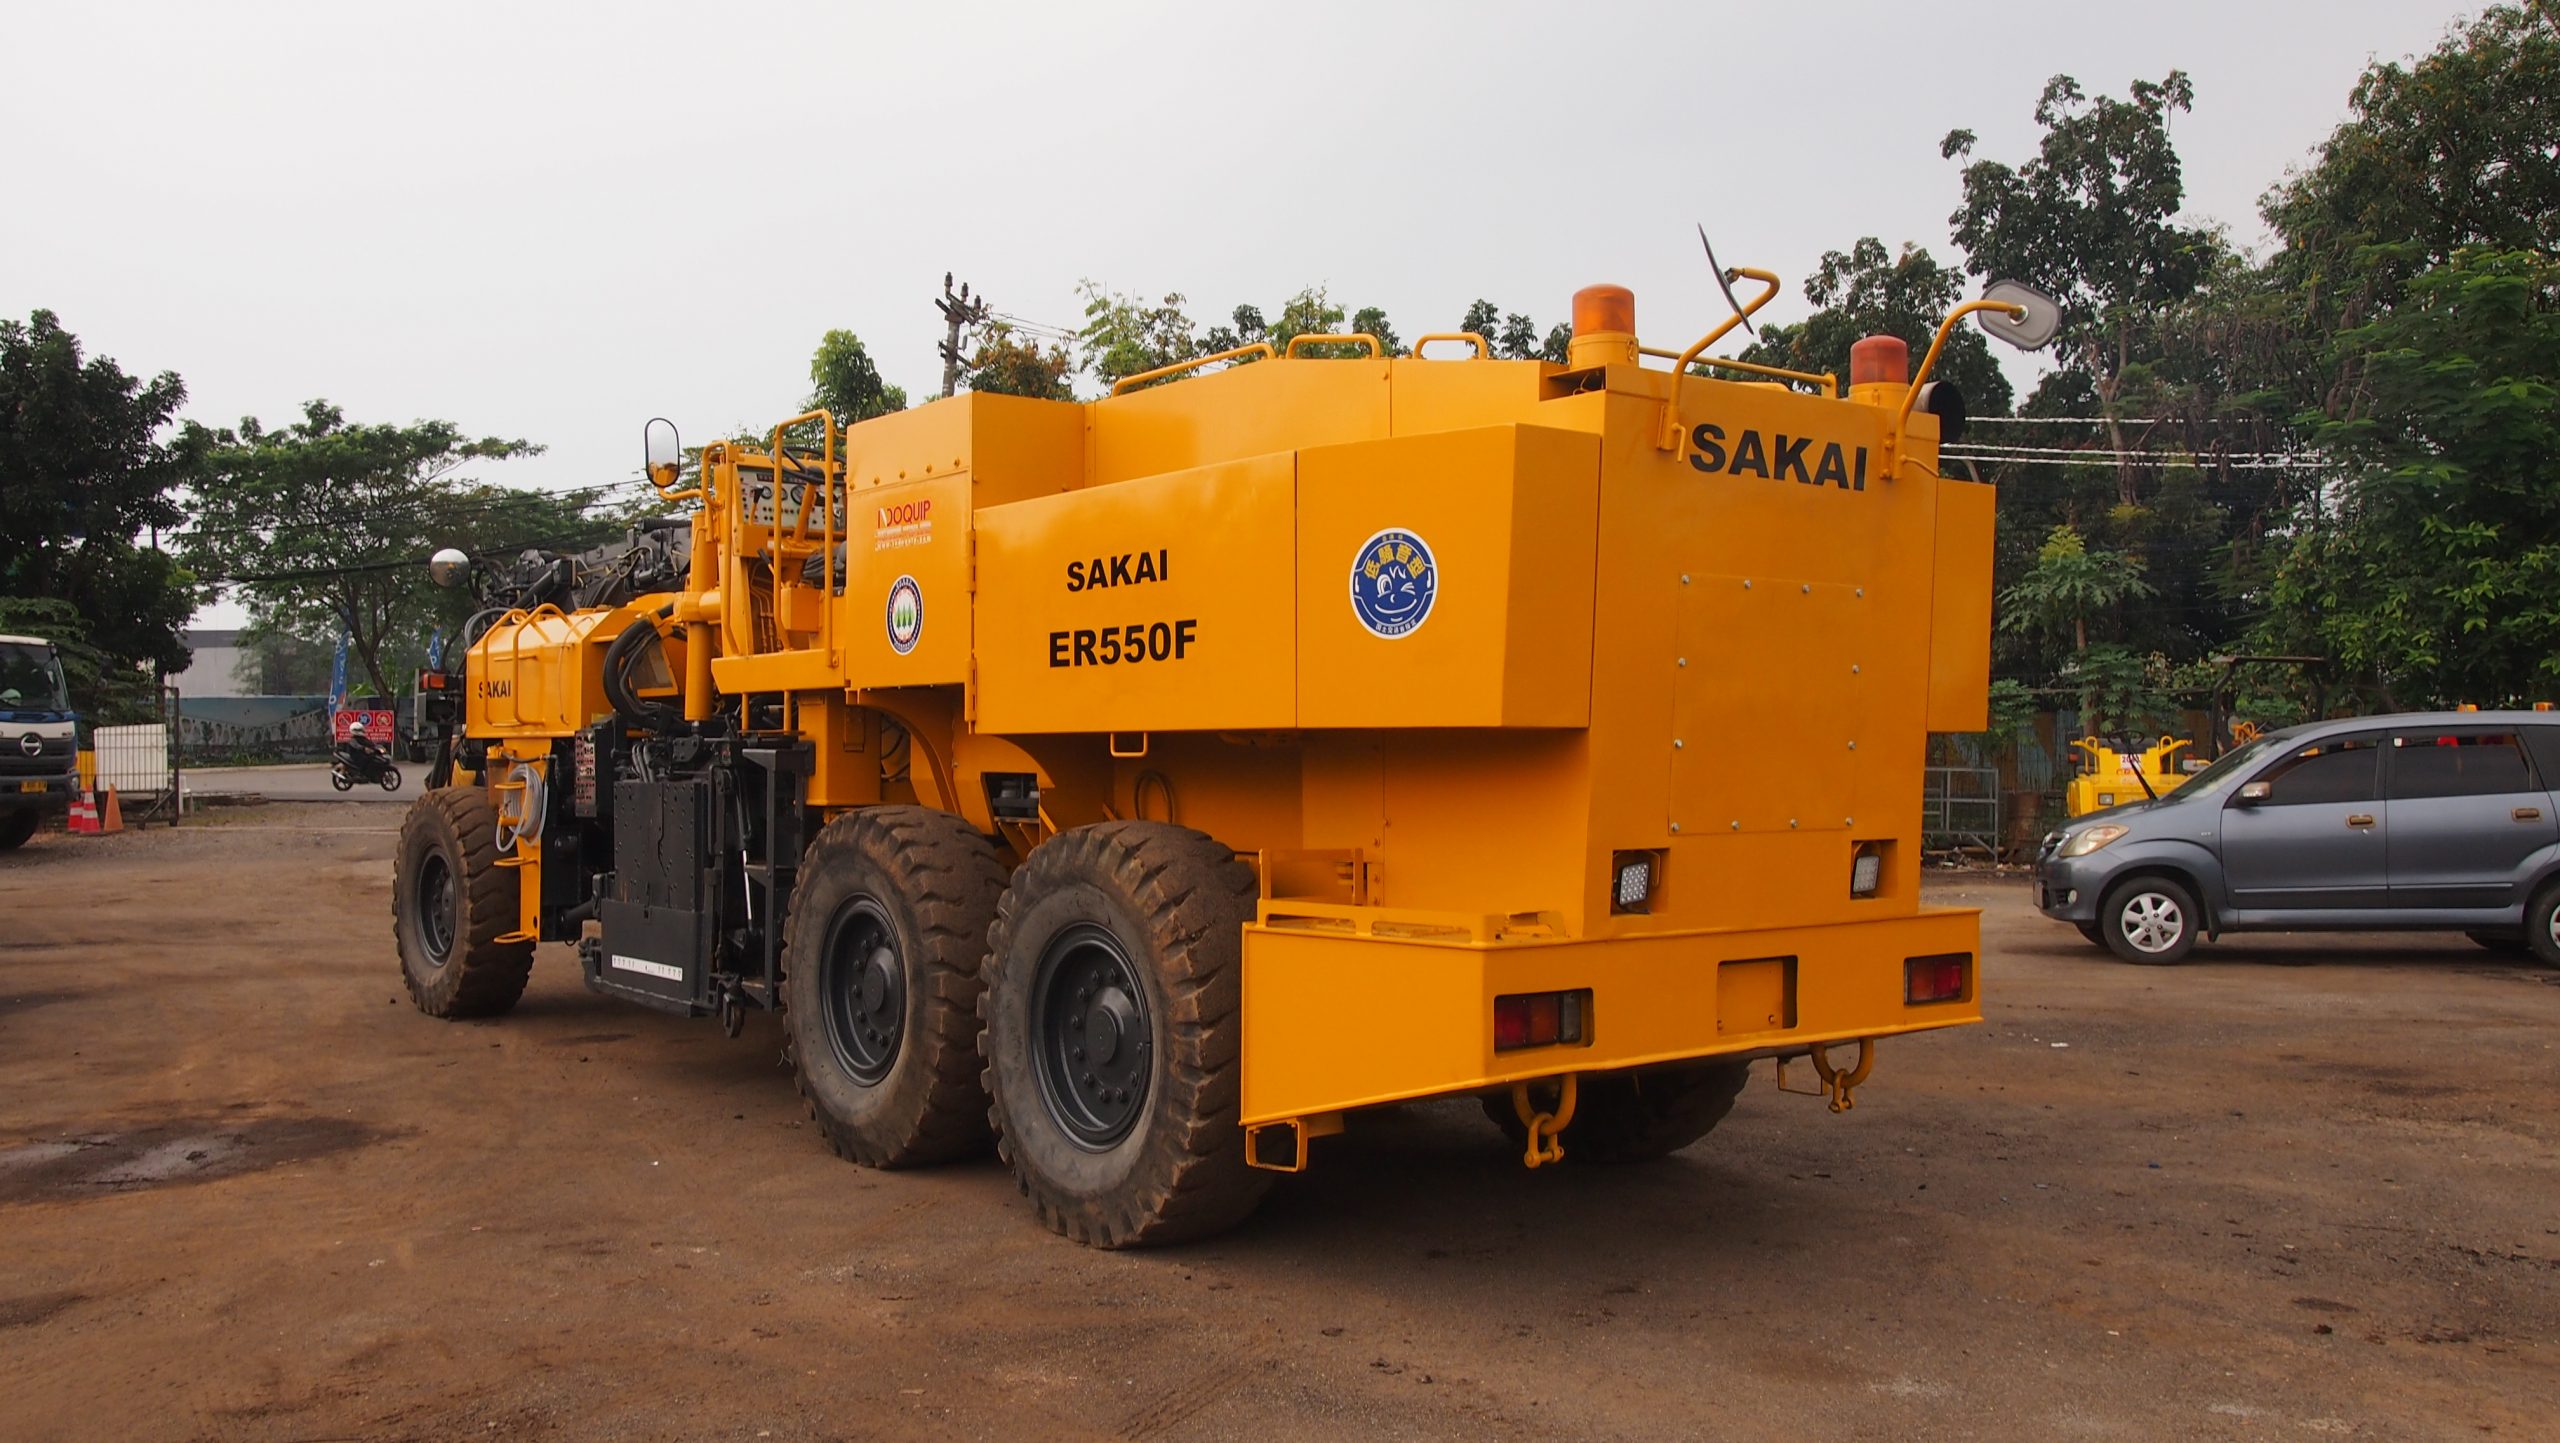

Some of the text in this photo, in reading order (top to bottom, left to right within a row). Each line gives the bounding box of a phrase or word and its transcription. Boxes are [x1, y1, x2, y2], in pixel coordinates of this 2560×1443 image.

[1689, 423, 1868, 492] SAKAI
[1066, 549, 1168, 592] SAKAI
[1049, 618, 1198, 668] ER550F
